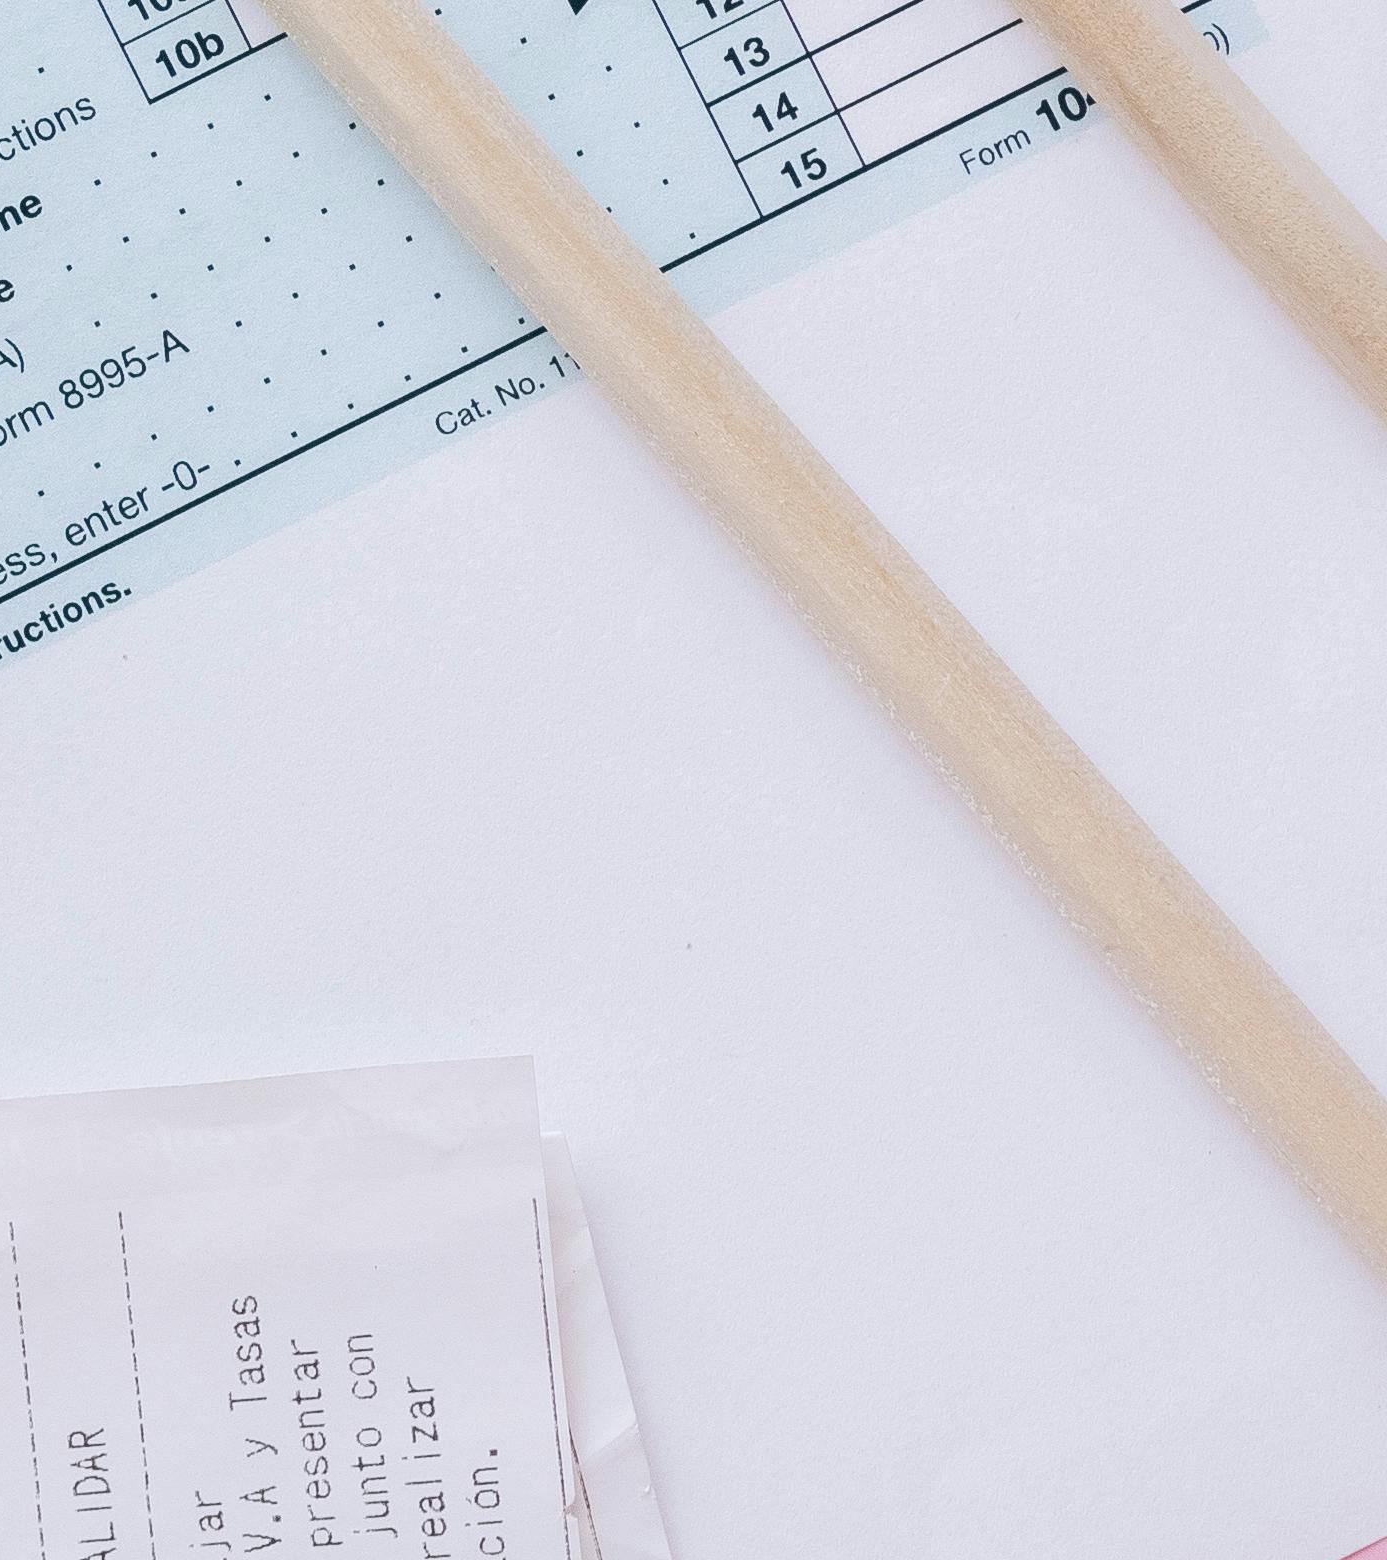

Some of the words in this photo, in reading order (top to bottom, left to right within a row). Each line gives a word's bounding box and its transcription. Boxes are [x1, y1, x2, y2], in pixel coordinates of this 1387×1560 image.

[779, 146, 828, 190] 15
[227, 1294, 269, 1413] Tasas
[345, 1332, 379, 1402] con
[243, 1436, 280, 1460] y
[288, 1337, 345, 1549] presentar
[349, 1425, 400, 1541] junto
